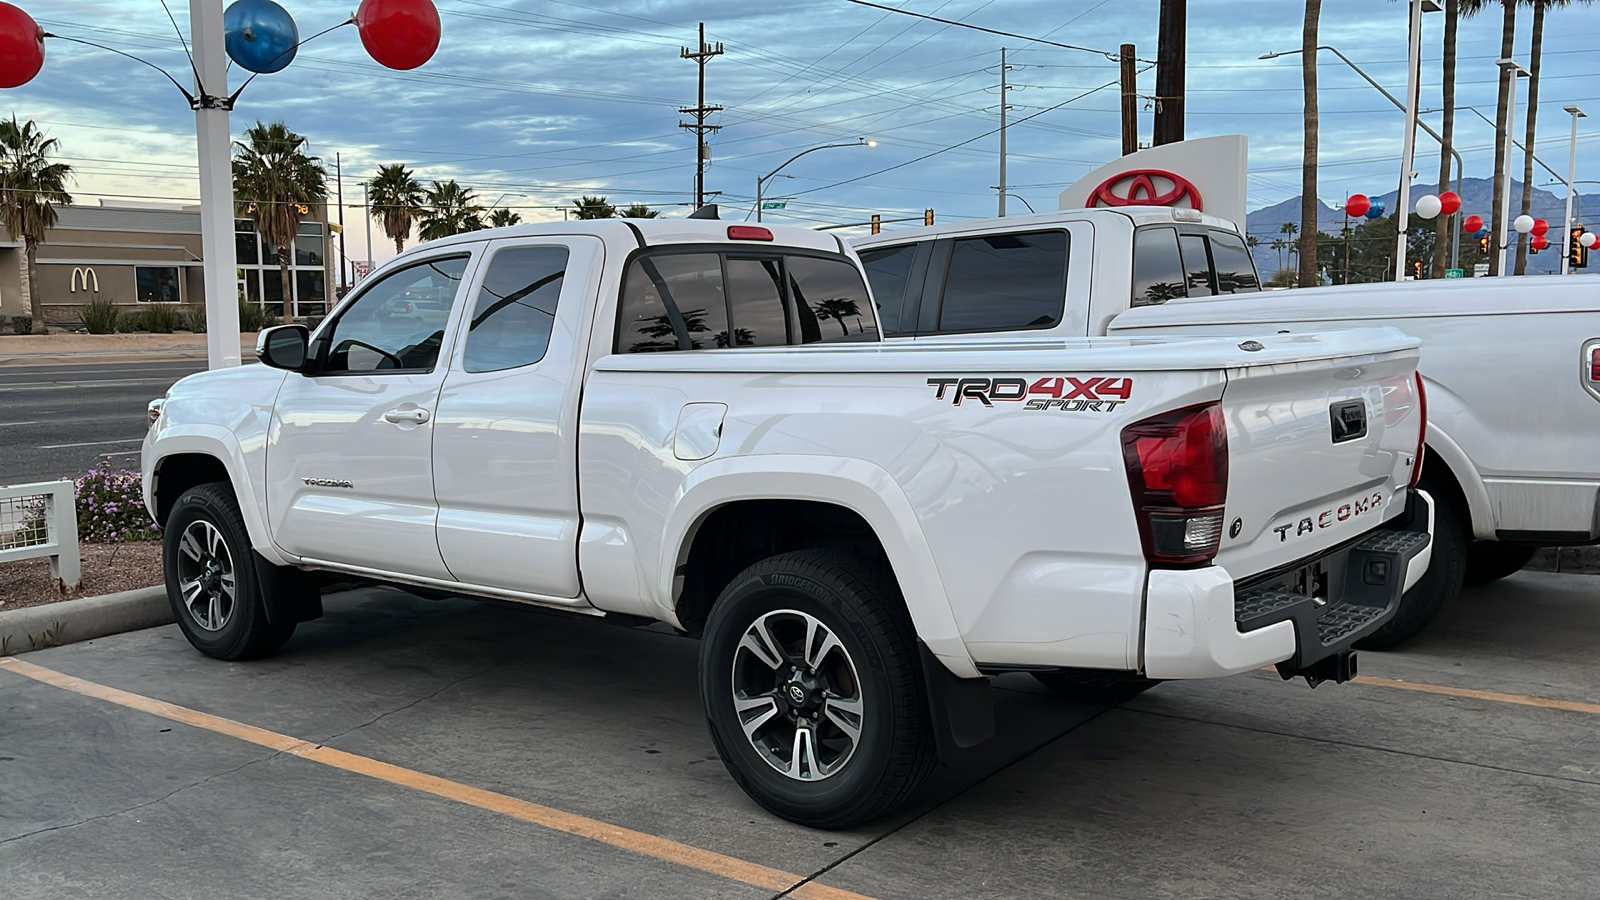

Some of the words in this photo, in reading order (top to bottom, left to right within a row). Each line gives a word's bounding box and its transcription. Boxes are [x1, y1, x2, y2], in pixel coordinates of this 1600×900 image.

[1023, 399, 1126, 413] SPORT
[301, 477, 354, 489] TACOMA
[1273, 491, 1382, 543] TACOMA
[771, 573, 837, 603] BRIDGESTONE
